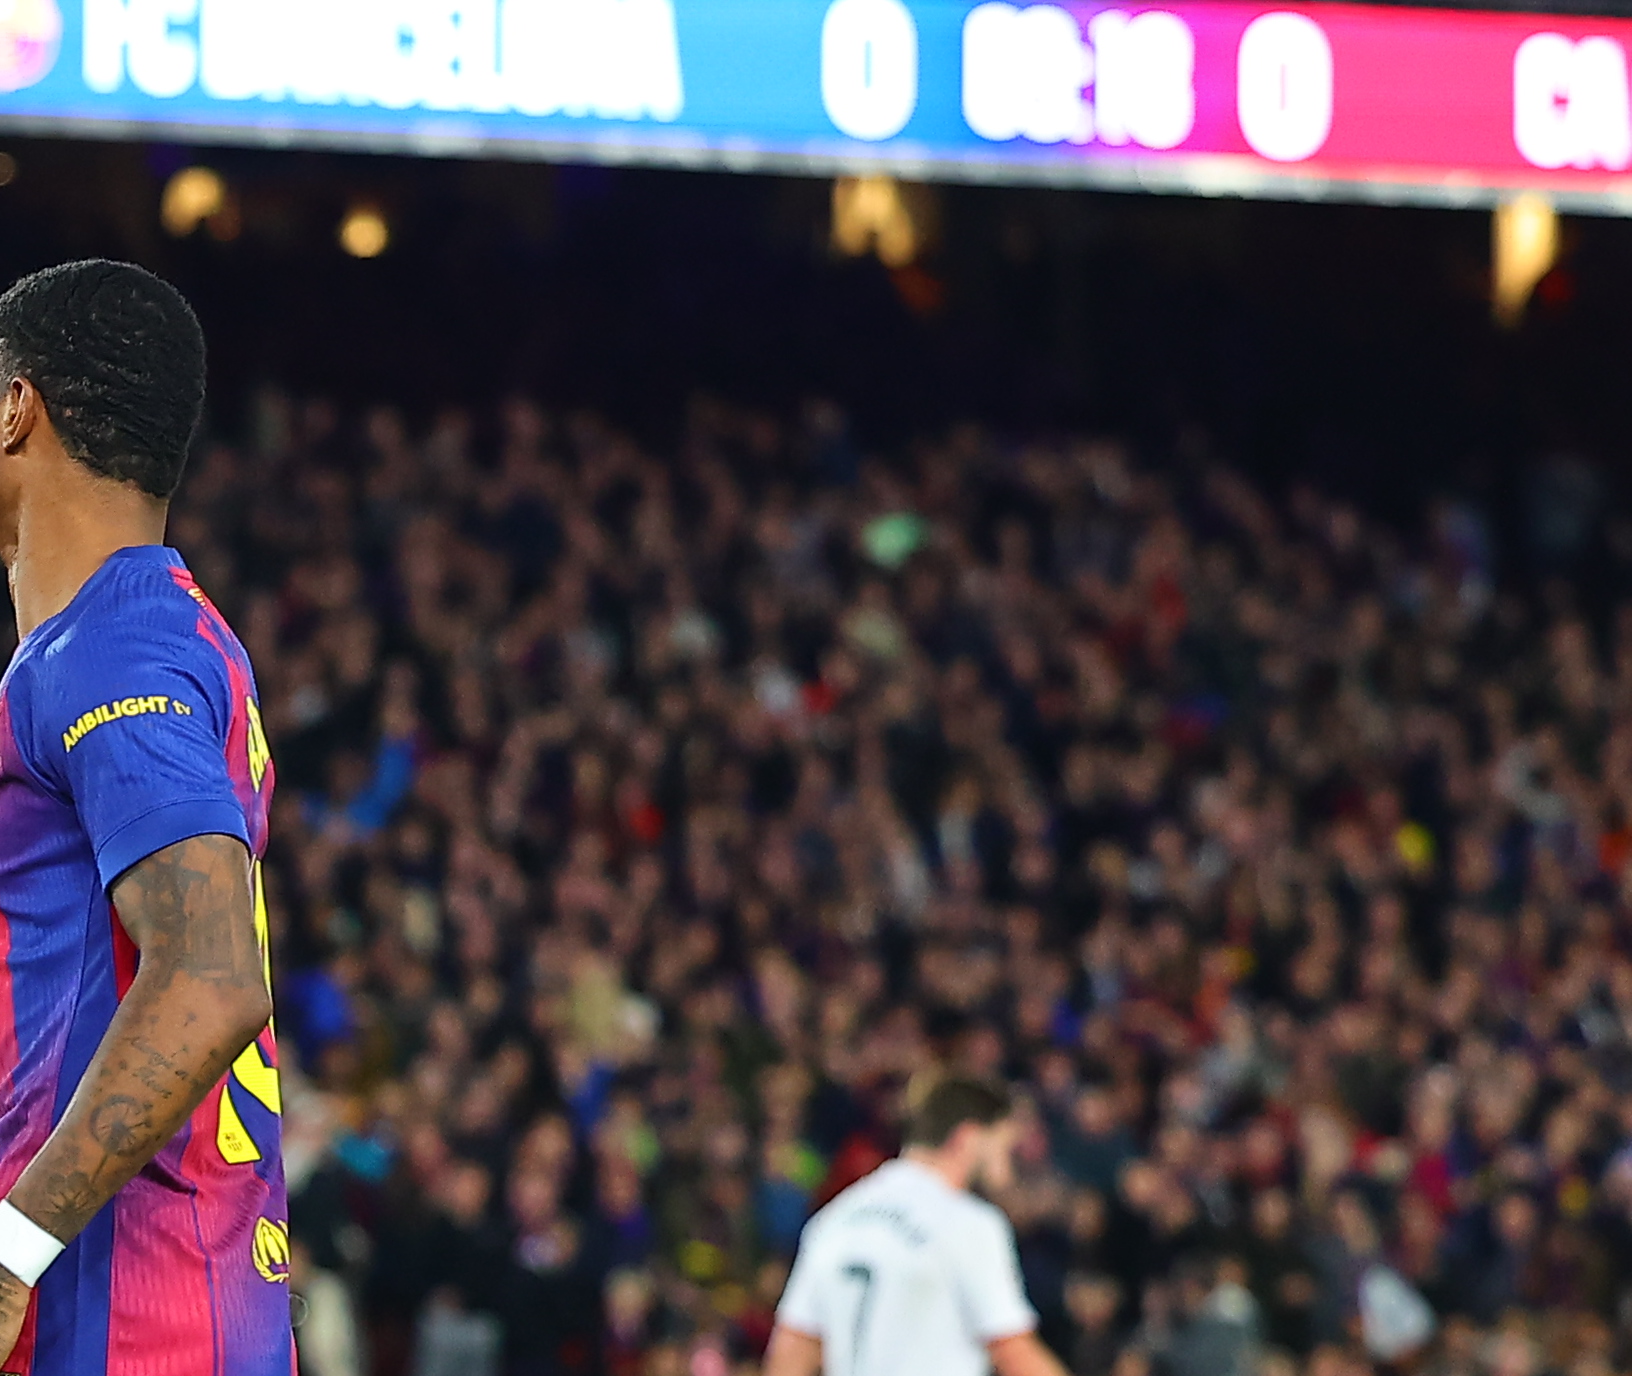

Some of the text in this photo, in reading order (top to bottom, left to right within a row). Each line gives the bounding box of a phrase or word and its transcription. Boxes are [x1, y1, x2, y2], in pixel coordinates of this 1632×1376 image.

[819, 0, 919, 141] 0
[1237, 11, 1333, 161] 0
[62, 696, 169, 753] AMBILIGHT
